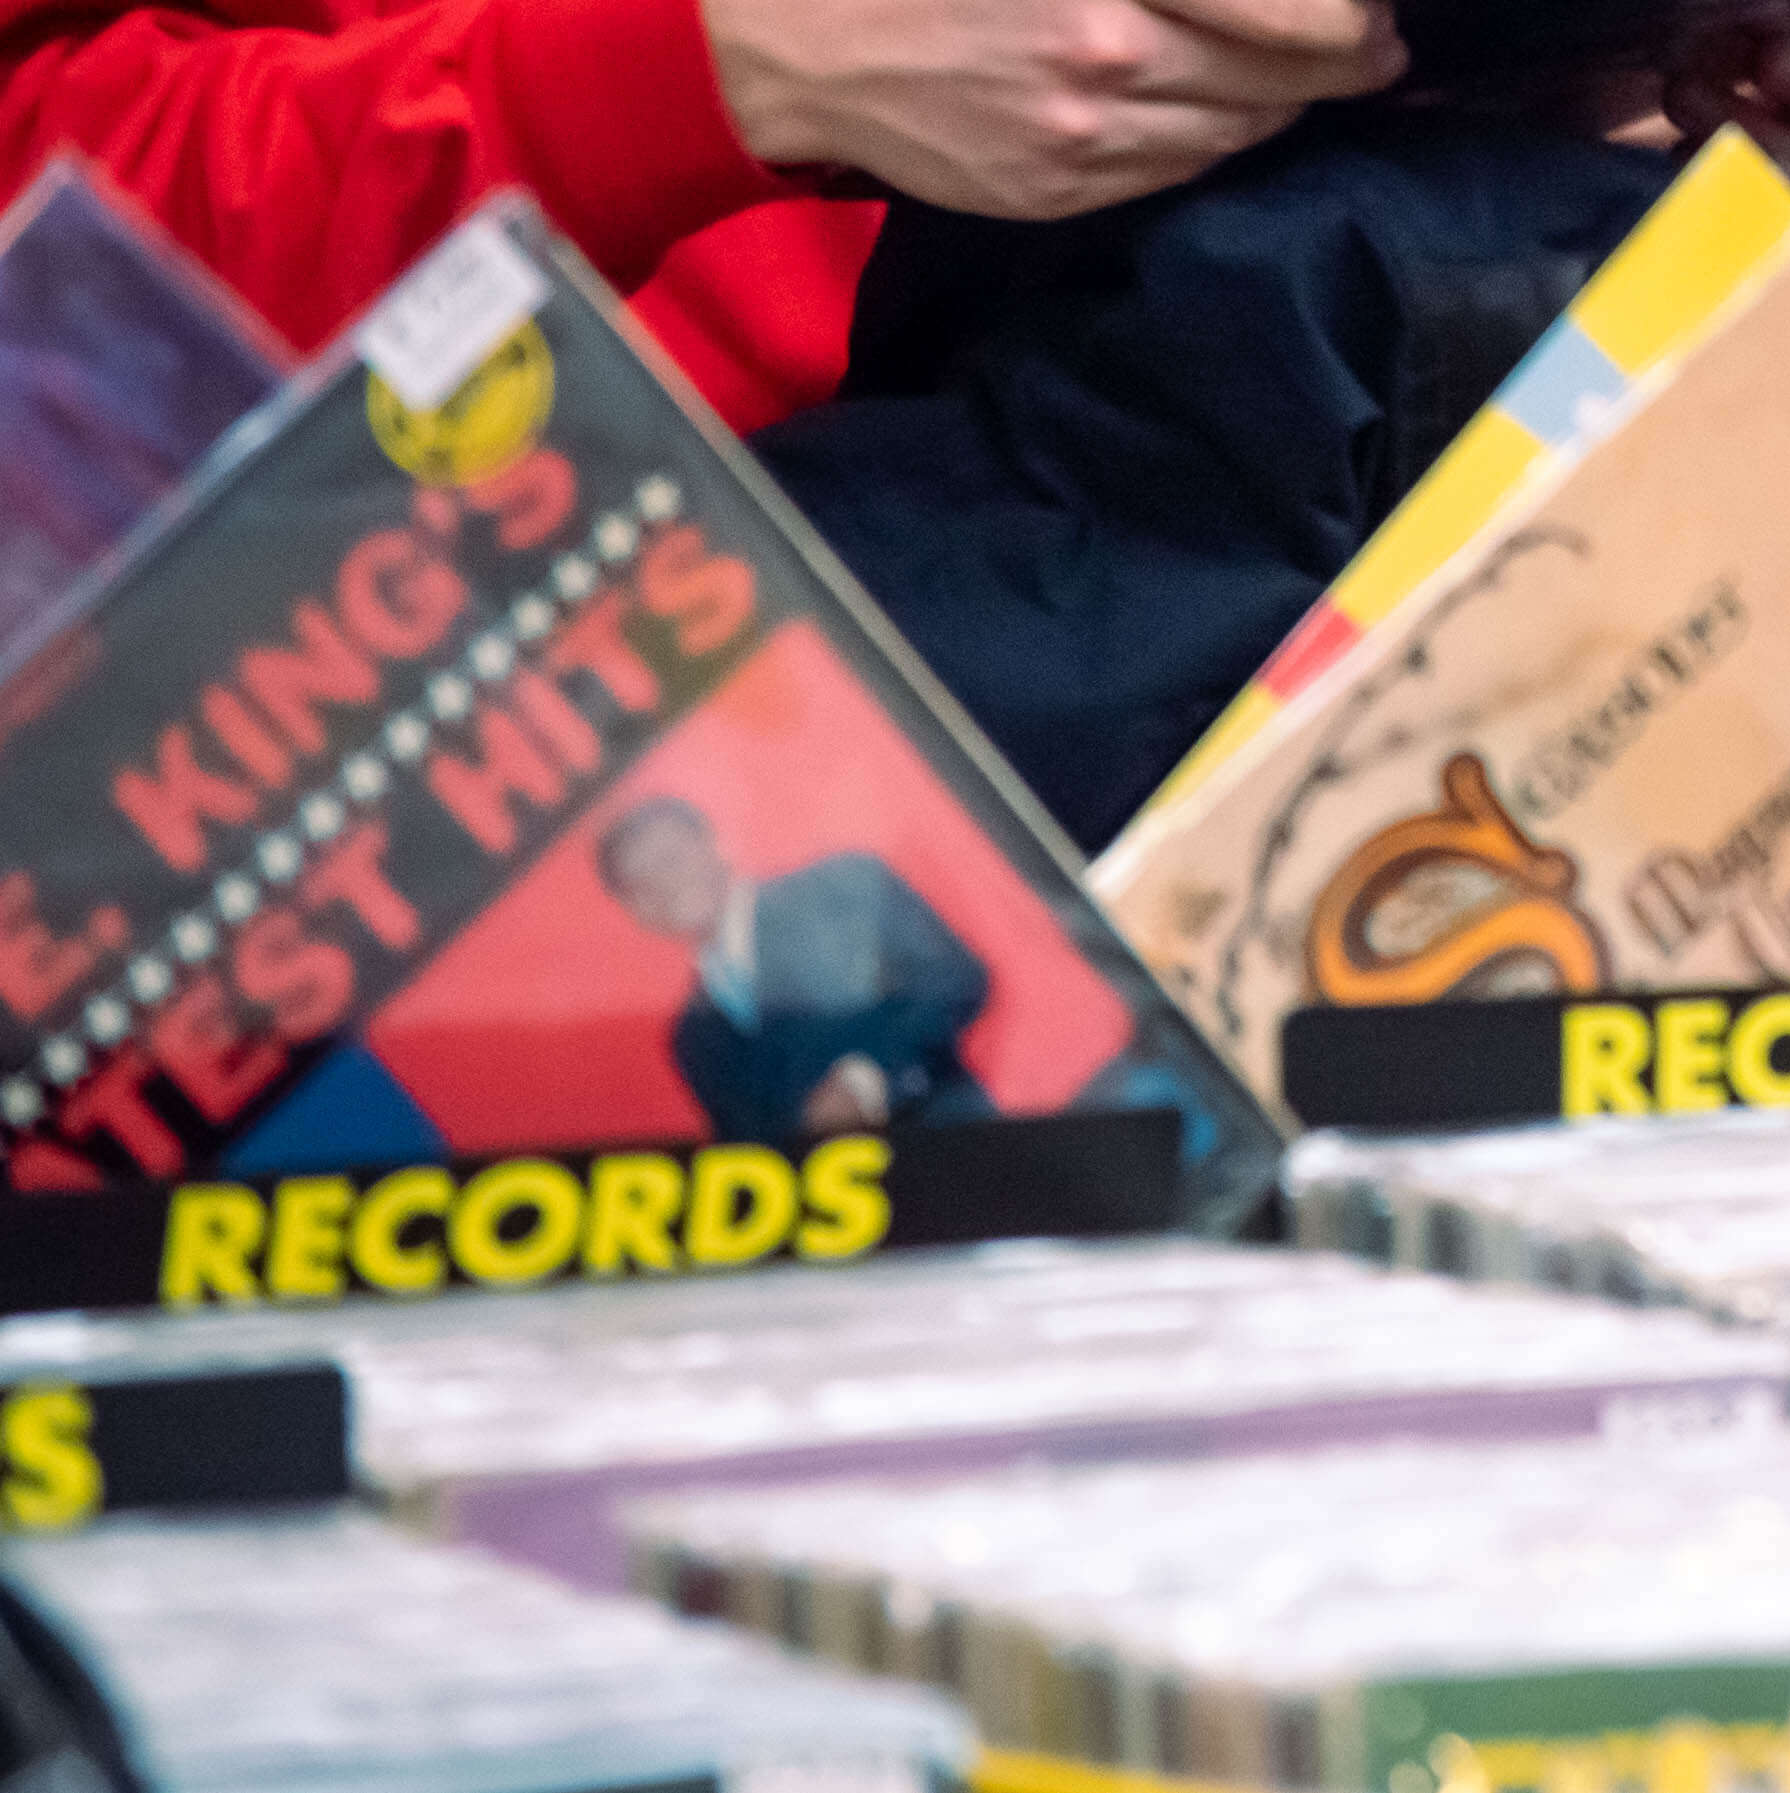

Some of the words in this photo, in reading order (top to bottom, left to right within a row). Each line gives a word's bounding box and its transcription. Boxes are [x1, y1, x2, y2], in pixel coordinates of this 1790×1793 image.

[113, 448, 579, 873] KING'S
[428, 522, 759, 856] HITS
[160, 1135, 894, 1311] RECORDS
